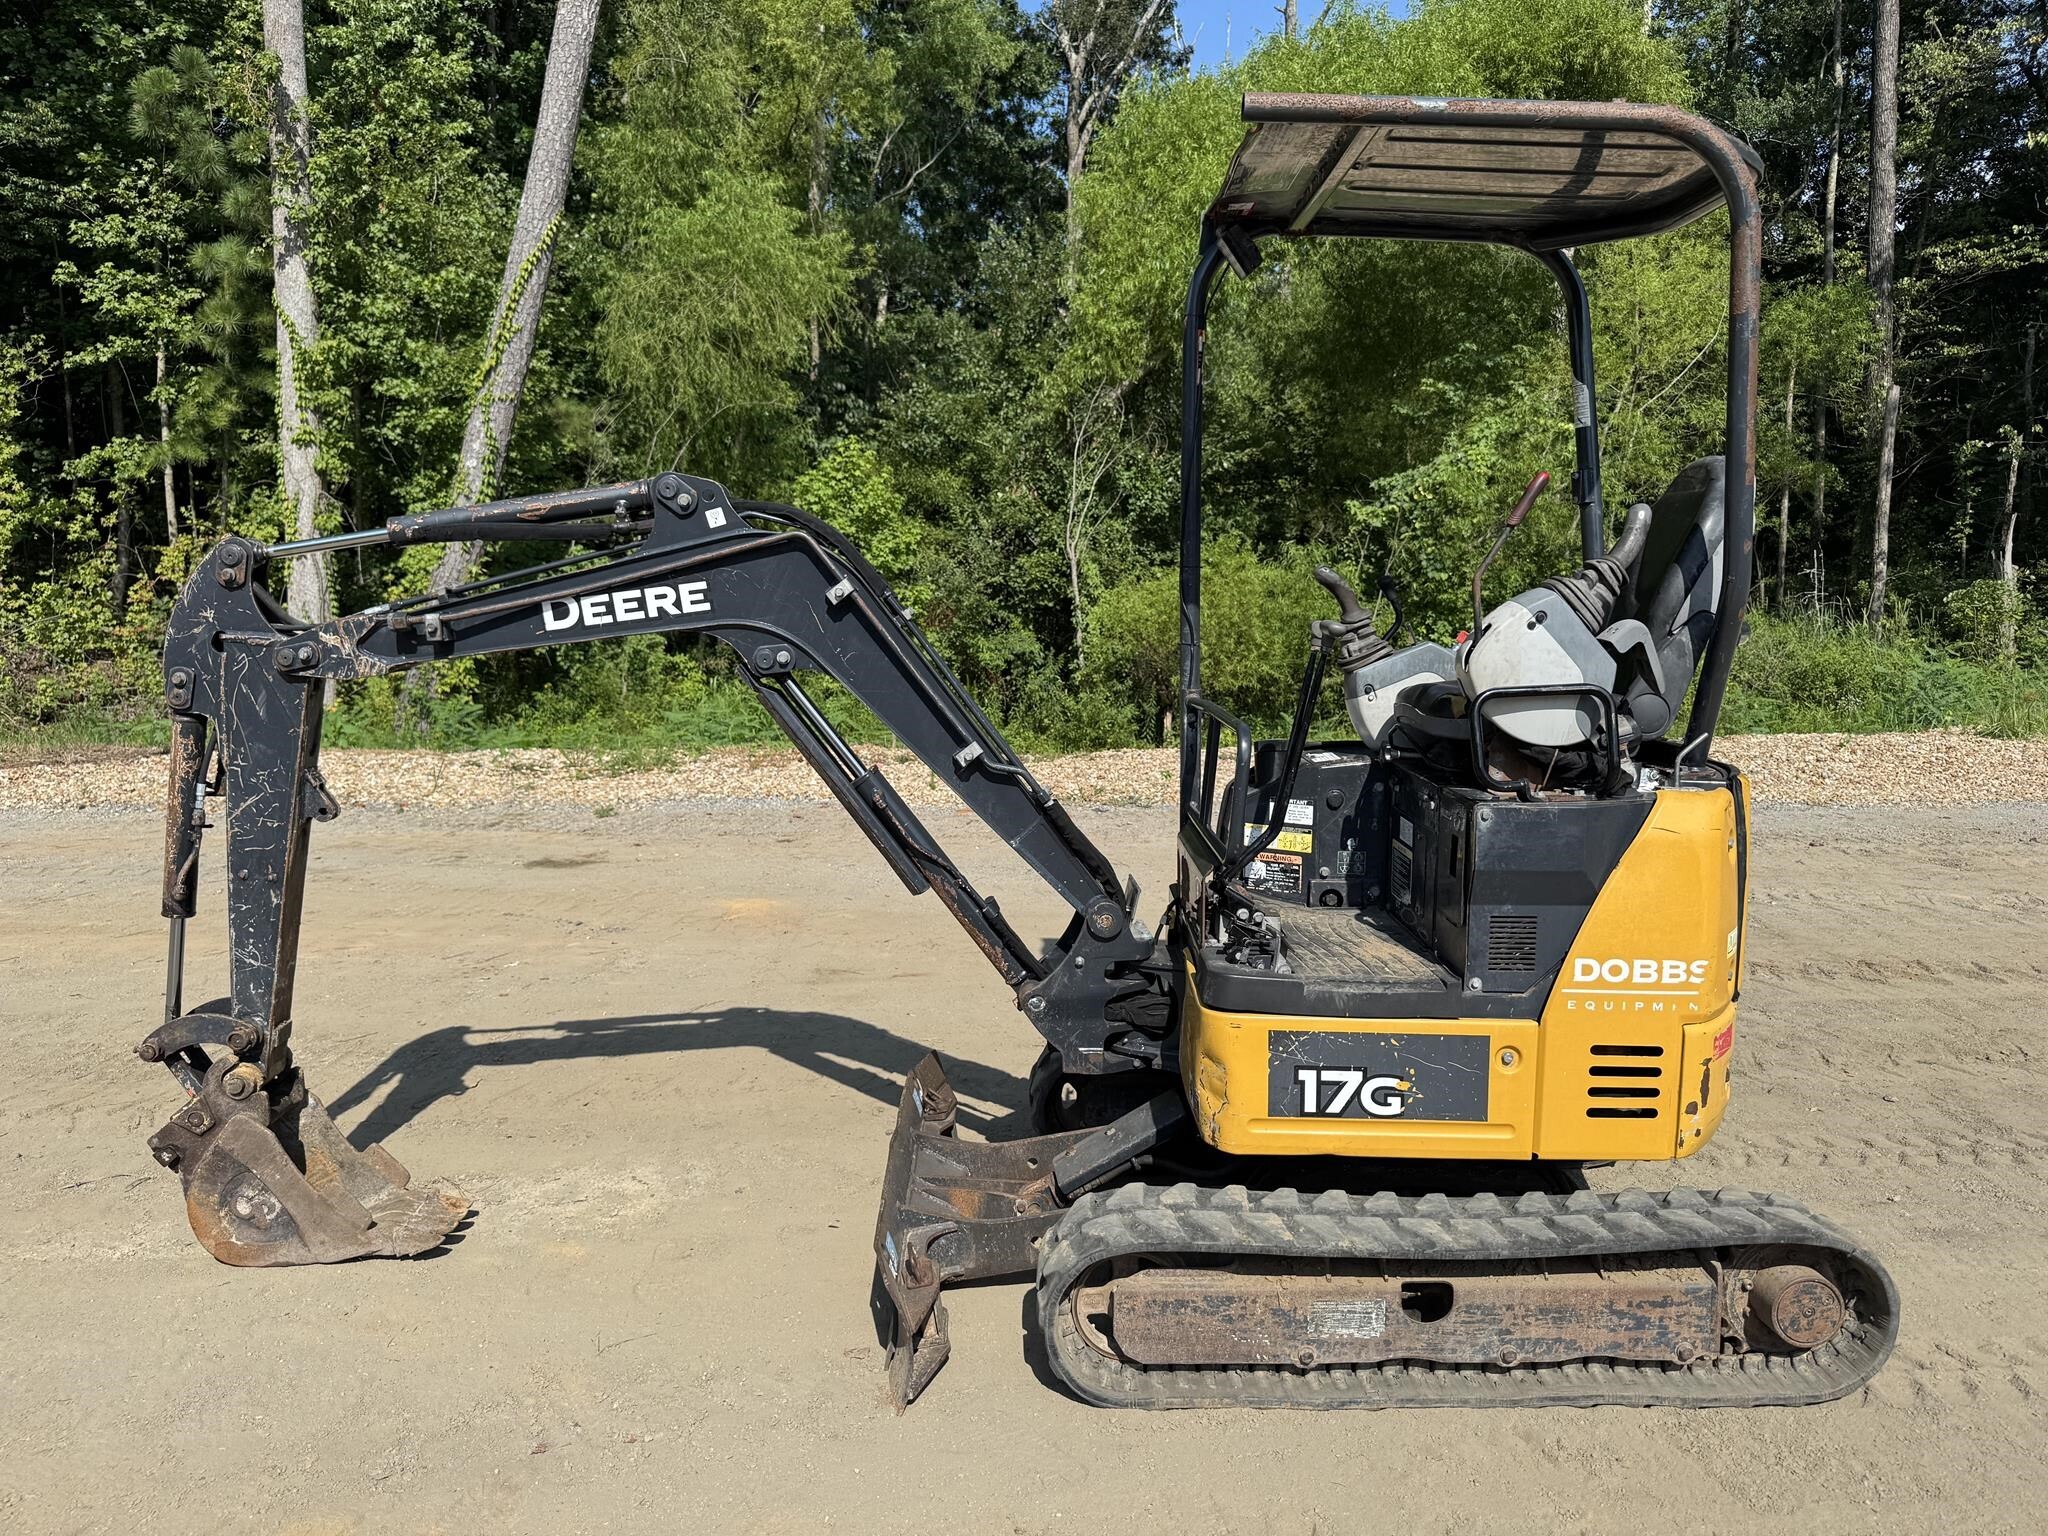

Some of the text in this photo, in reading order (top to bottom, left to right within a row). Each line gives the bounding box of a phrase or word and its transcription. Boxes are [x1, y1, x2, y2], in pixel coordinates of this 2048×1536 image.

[541, 581, 711, 631] DEERE
[1573, 957, 1709, 984] DOBBS
[1297, 1067, 1403, 1117] 17G
